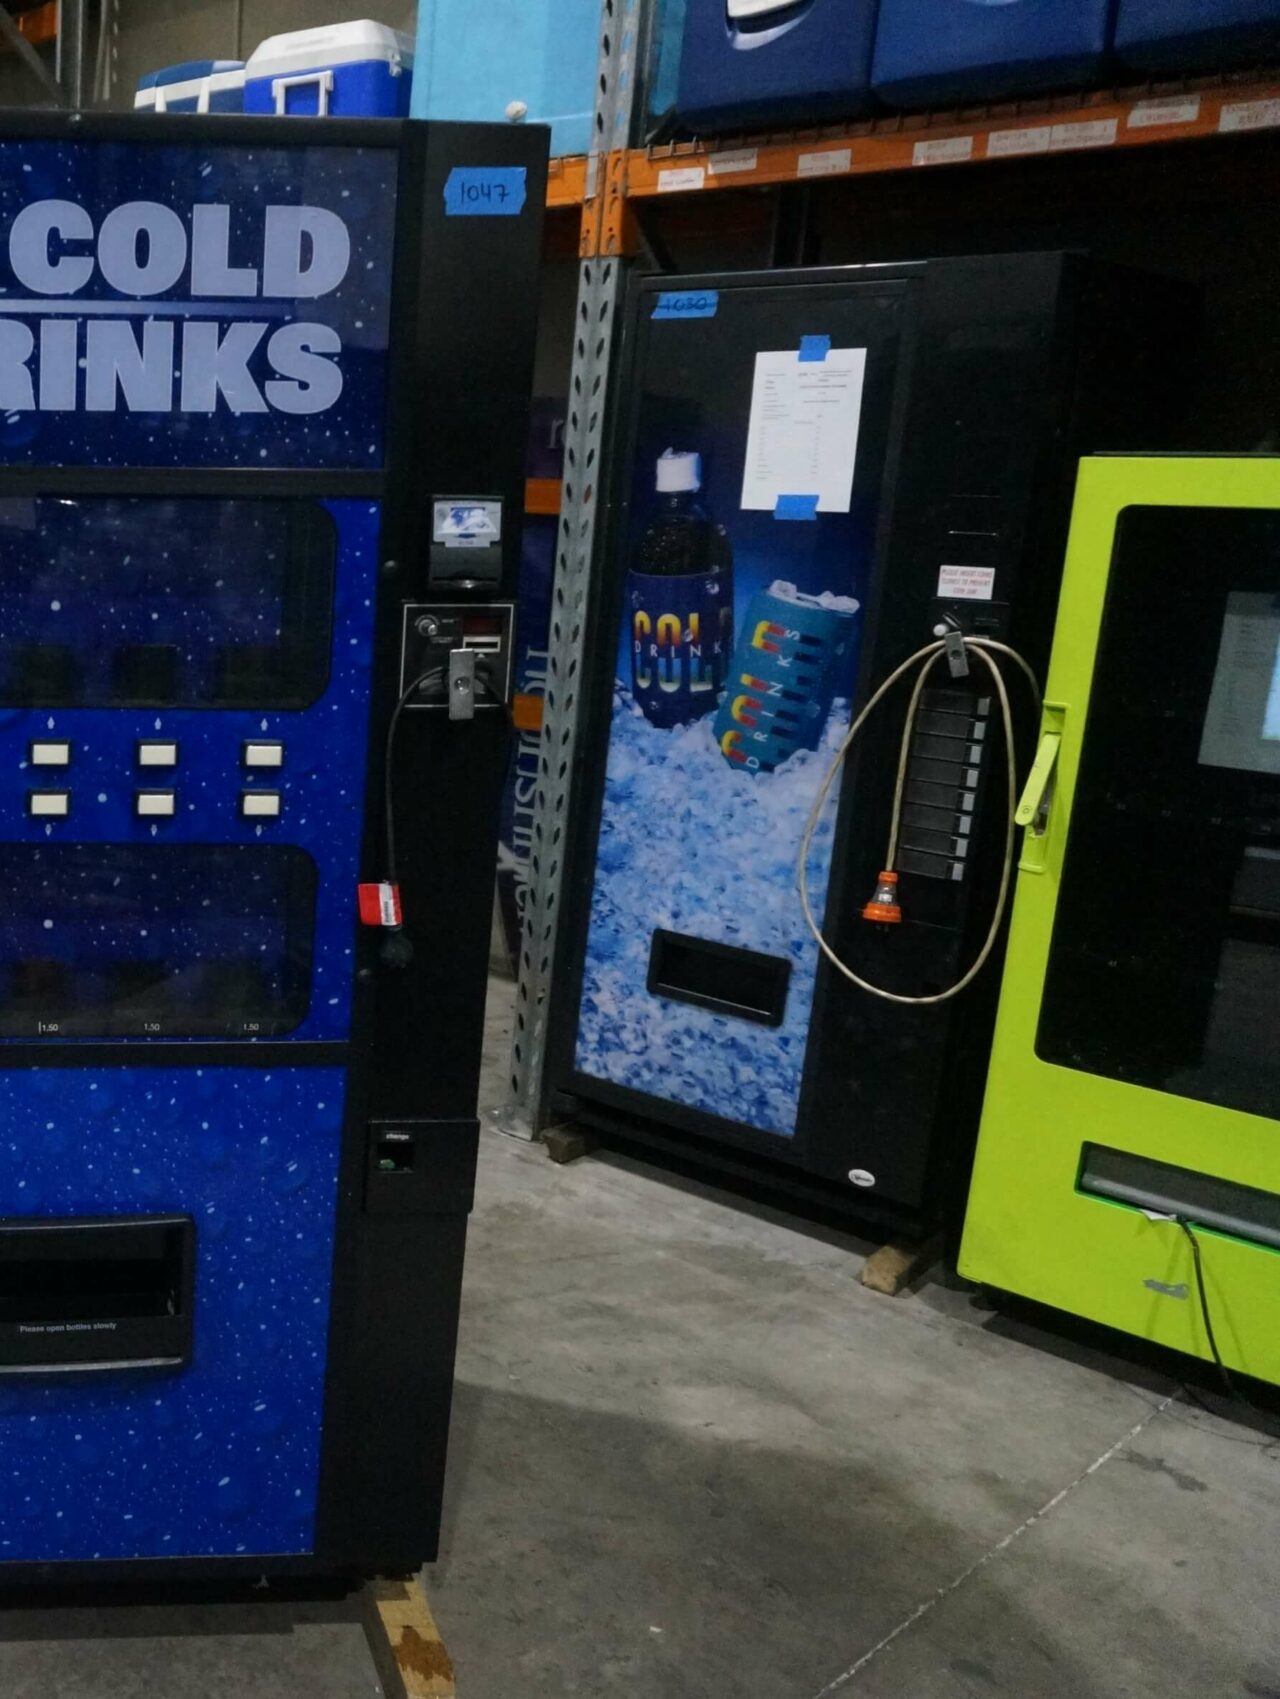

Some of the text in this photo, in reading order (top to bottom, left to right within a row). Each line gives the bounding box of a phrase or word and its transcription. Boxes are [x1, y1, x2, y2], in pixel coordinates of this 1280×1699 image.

[460, 181, 510, 206] 1047
[9, 199, 351, 298] COLD
[42, 1023, 59, 1032] 1.50
[143, 1022, 160, 1032] 1.50
[243, 1022, 260, 1031] 1.50
[20, 1321, 117, 1334] Please open bottles slowly
